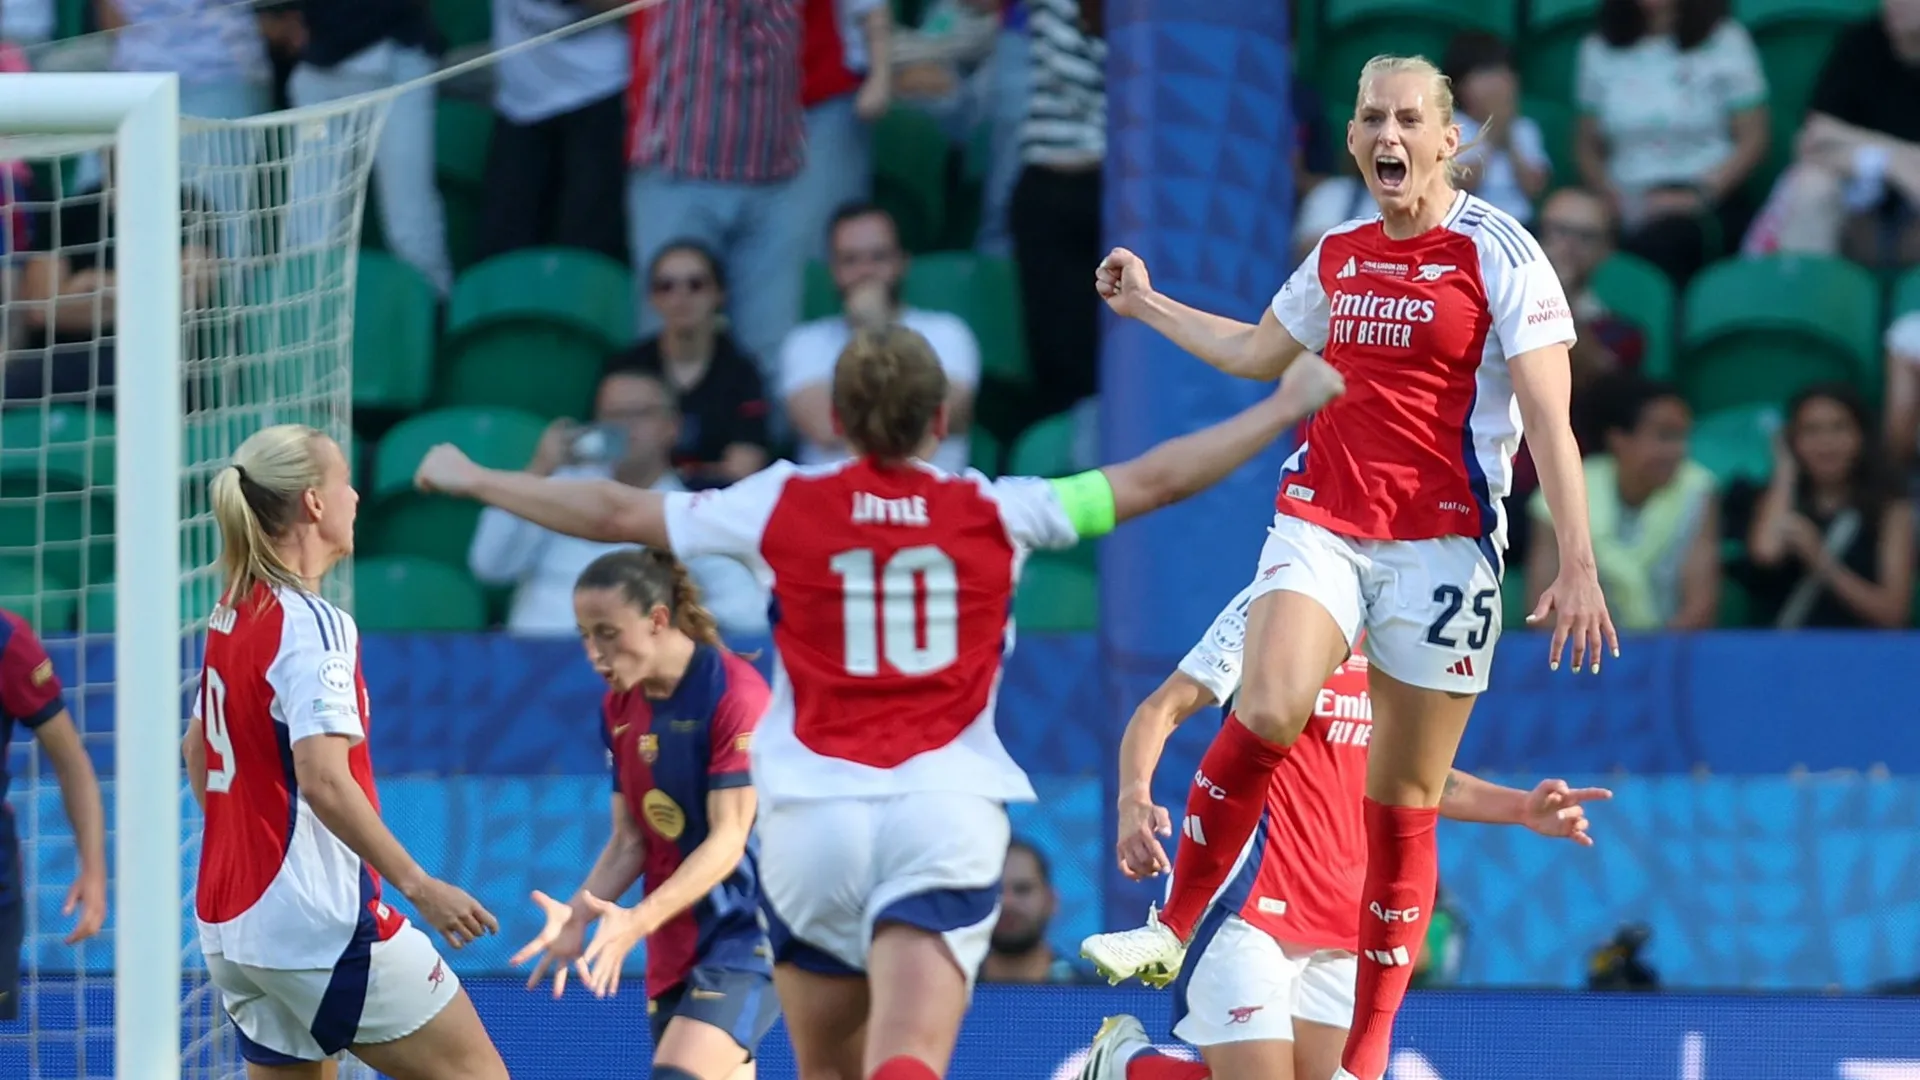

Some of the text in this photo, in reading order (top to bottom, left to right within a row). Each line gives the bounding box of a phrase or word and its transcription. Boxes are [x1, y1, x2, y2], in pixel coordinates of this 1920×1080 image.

[1330, 290, 1435, 323] Emirates
[1333, 319, 1412, 348] FLY BETTER
[852, 490, 931, 527] LITTLE
[829, 543, 959, 677] 10
[1427, 584, 1497, 650] 25
[206, 664, 237, 794] 9
[1194, 768, 1227, 800] AFC
[1369, 900, 1420, 924] AFC
